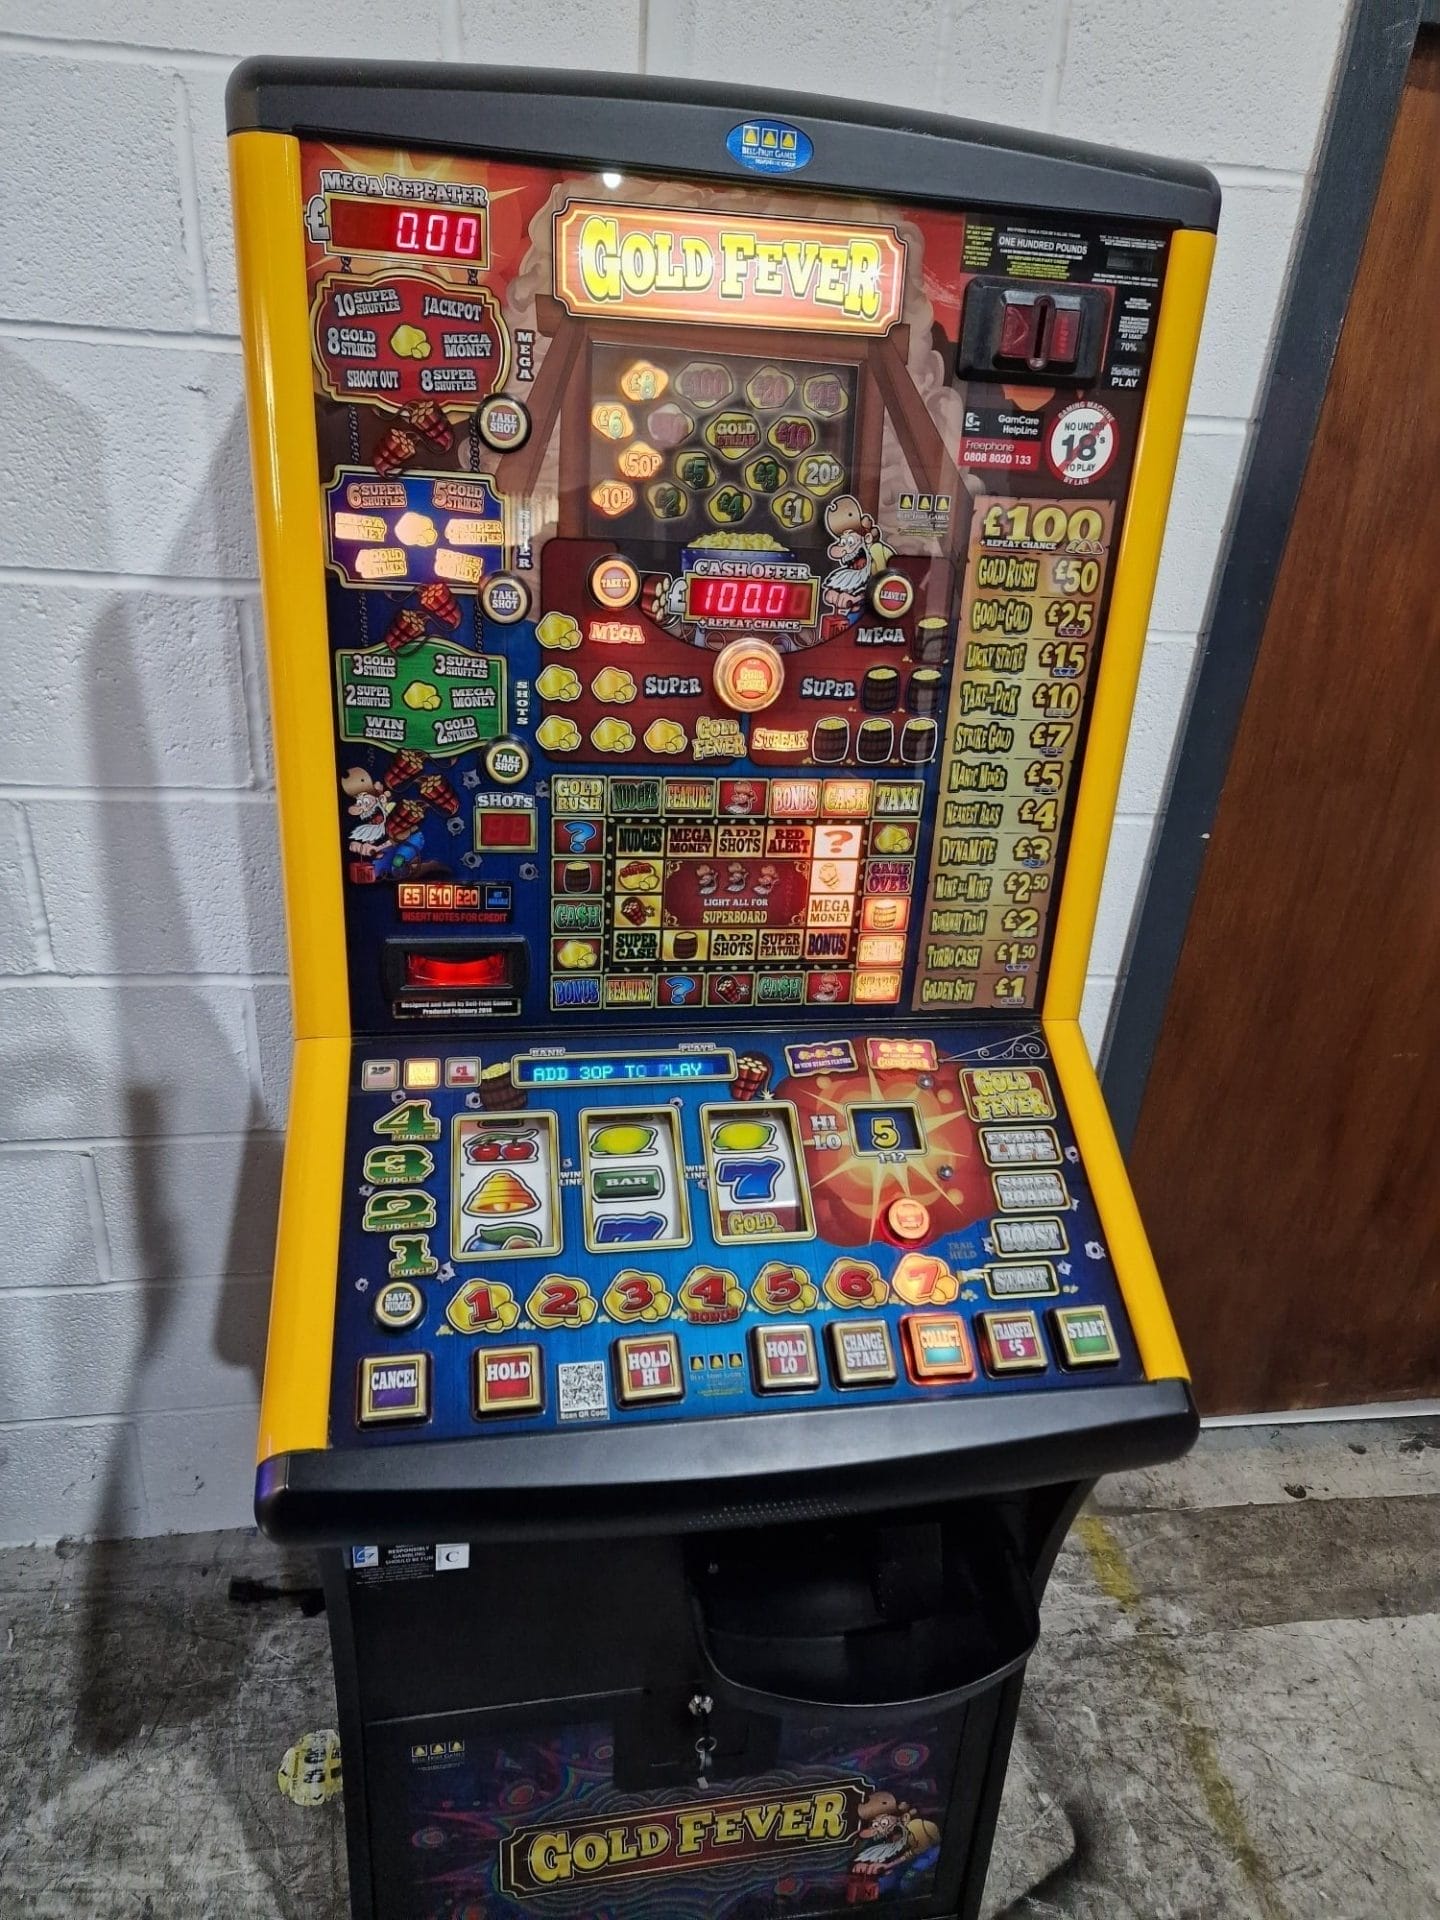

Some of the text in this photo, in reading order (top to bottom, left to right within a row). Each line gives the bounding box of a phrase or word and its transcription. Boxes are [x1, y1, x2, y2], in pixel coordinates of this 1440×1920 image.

[775, 150, 796, 159] GAMES
[323, 172, 487, 206] MEGA REPEATER
[307, 198, 330, 240] £
[999, 237, 1015, 246] ONE
[1017, 239, 1054, 251] HUNDRED
[1056, 242, 1087, 254] POUNDS
[581, 217, 713, 302] GOLD
[719, 233, 880, 319] FEVER
[335, 289, 398, 316] 10 SUPER
[424, 297, 482, 321] JACKPOT
[328, 328, 375, 354] 8 GOLD
[1121, 343, 1137, 352] 70%
[445, 343, 491, 357] MONEY
[422, 370, 475, 390] 8 SUPER
[1112, 377, 1138, 387] PLAY
[490, 412, 517, 424] TAKE
[998, 415, 1039, 425] GamCare
[1058, 402, 1115, 422] GAMING MACHINE
[490, 422, 517, 434] SHOT
[717, 423, 755, 434] GOLD
[1003, 425, 1038, 436] HelpLine
[1065, 422, 1076, 430] NO
[966, 441, 1014, 452] Freephone
[964, 452, 1031, 464] 0808 8020 133
[433, 481, 483, 506] 5 GOLD
[983, 505, 1102, 542] £100
[696, 562, 809, 579] CASH OFFER
[1056, 558, 1098, 594] £50
[492, 591, 517, 600] TAKE
[881, 590, 906, 601] LEAVE IT
[492, 599, 517, 609] SHOT
[1048, 601, 1094, 636] £25
[591, 624, 642, 643] MEGA
[857, 628, 904, 643] MEGA
[353, 655, 395, 674] 3 GOLD
[435, 655, 488, 674] 3 SUPER
[1041, 644, 1085, 674] £15
[446, 668, 487, 678] SHUFFLES
[452, 688, 495, 697] MEGA
[645, 678, 700, 695] SUPER
[803, 679, 854, 697] SUPER
[347, 686, 390, 705] 2 SUPER
[453, 697, 496, 708] MONEY
[1035, 684, 1080, 715] £10
[366, 717, 405, 728] WIN
[366, 729, 404, 740] SERIES
[435, 718, 475, 744] 2 GOLD
[1032, 724, 1073, 748] £7
[753, 730, 808, 749] STREAK
[495, 754, 520, 763] TAKE
[495, 763, 520, 772] SHOT
[1026, 761, 1063, 788] £5
[556, 779, 603, 796] GOLD
[478, 794, 533, 808] SHOTS
[556, 796, 601, 811] RUSH
[667, 785, 712, 808] FEATURE
[774, 786, 817, 812] BONUS
[878, 786, 919, 810] TAXI
[1020, 800, 1057, 831] £4
[619, 826, 662, 852] NUDGES
[670, 828, 712, 842] MEGA
[775, 829, 805, 839] RED
[669, 843, 711, 852] MONEY
[768, 840, 809, 853] ALERT
[940, 837, 997, 865] DYNAMITE
[1014, 836, 1051, 863] £3
[404, 888, 420, 904] £5
[430, 888, 450, 904] £10
[457, 889, 477, 906] £20
[811, 899, 850, 912] MEGA
[402, 912, 507, 922] INSERT NOTES FOR CREDIT
[703, 910, 768, 924] SUPERBOARD
[810, 913, 849, 922] MONEY
[1003, 908, 1038, 933] £2
[616, 933, 657, 947] SUPER
[714, 934, 753, 942] ADD
[762, 933, 800, 945] SUPER
[809, 933, 847, 955] BONUS
[615, 949, 656, 959] CASH
[760, 946, 799, 956] FEATURE
[554, 979, 599, 1006] BONUS
[607, 980, 650, 1001] FEATURE
[532, 1048, 564, 1056] BANK
[534, 1063, 702, 1081] ADD 30P TO PLAY
[975, 1071, 1030, 1095] GOLD
[972, 1088, 1048, 1120] FEVER
[811, 1116, 837, 1130] HI
[814, 1134, 842, 1150] LO
[872, 1118, 899, 1150] 5
[879, 1152, 906, 1163] 1-12
[606, 1176, 647, 1186] BAR
[948, 1241, 973, 1251] TRAIL
[950, 1250, 977, 1260] HELD
[391, 1269, 433, 1277] NUDGE
[386, 1293, 411, 1303] SAVE
[385, 1301, 412, 1312] NUDGES
[992, 1323, 1033, 1339] TRANSFER
[1068, 1320, 1106, 1338] START
[843, 1333, 884, 1351] CHANGE
[920, 1330, 961, 1348] COLLECT
[766, 1340, 807, 1358] HOLD
[628, 1351, 670, 1370] HOLD
[781, 1358, 798, 1374] LO
[846, 1351, 887, 1368] STAKE
[372, 1369, 417, 1390] CANCEL
[487, 1363, 530, 1381] HOLD
[641, 1369, 660, 1386] HI
[560, 1412, 577, 1420] Scan
[578, 1411, 589, 1419] QR
[530, 1792, 846, 1883] GOLD FEVER
